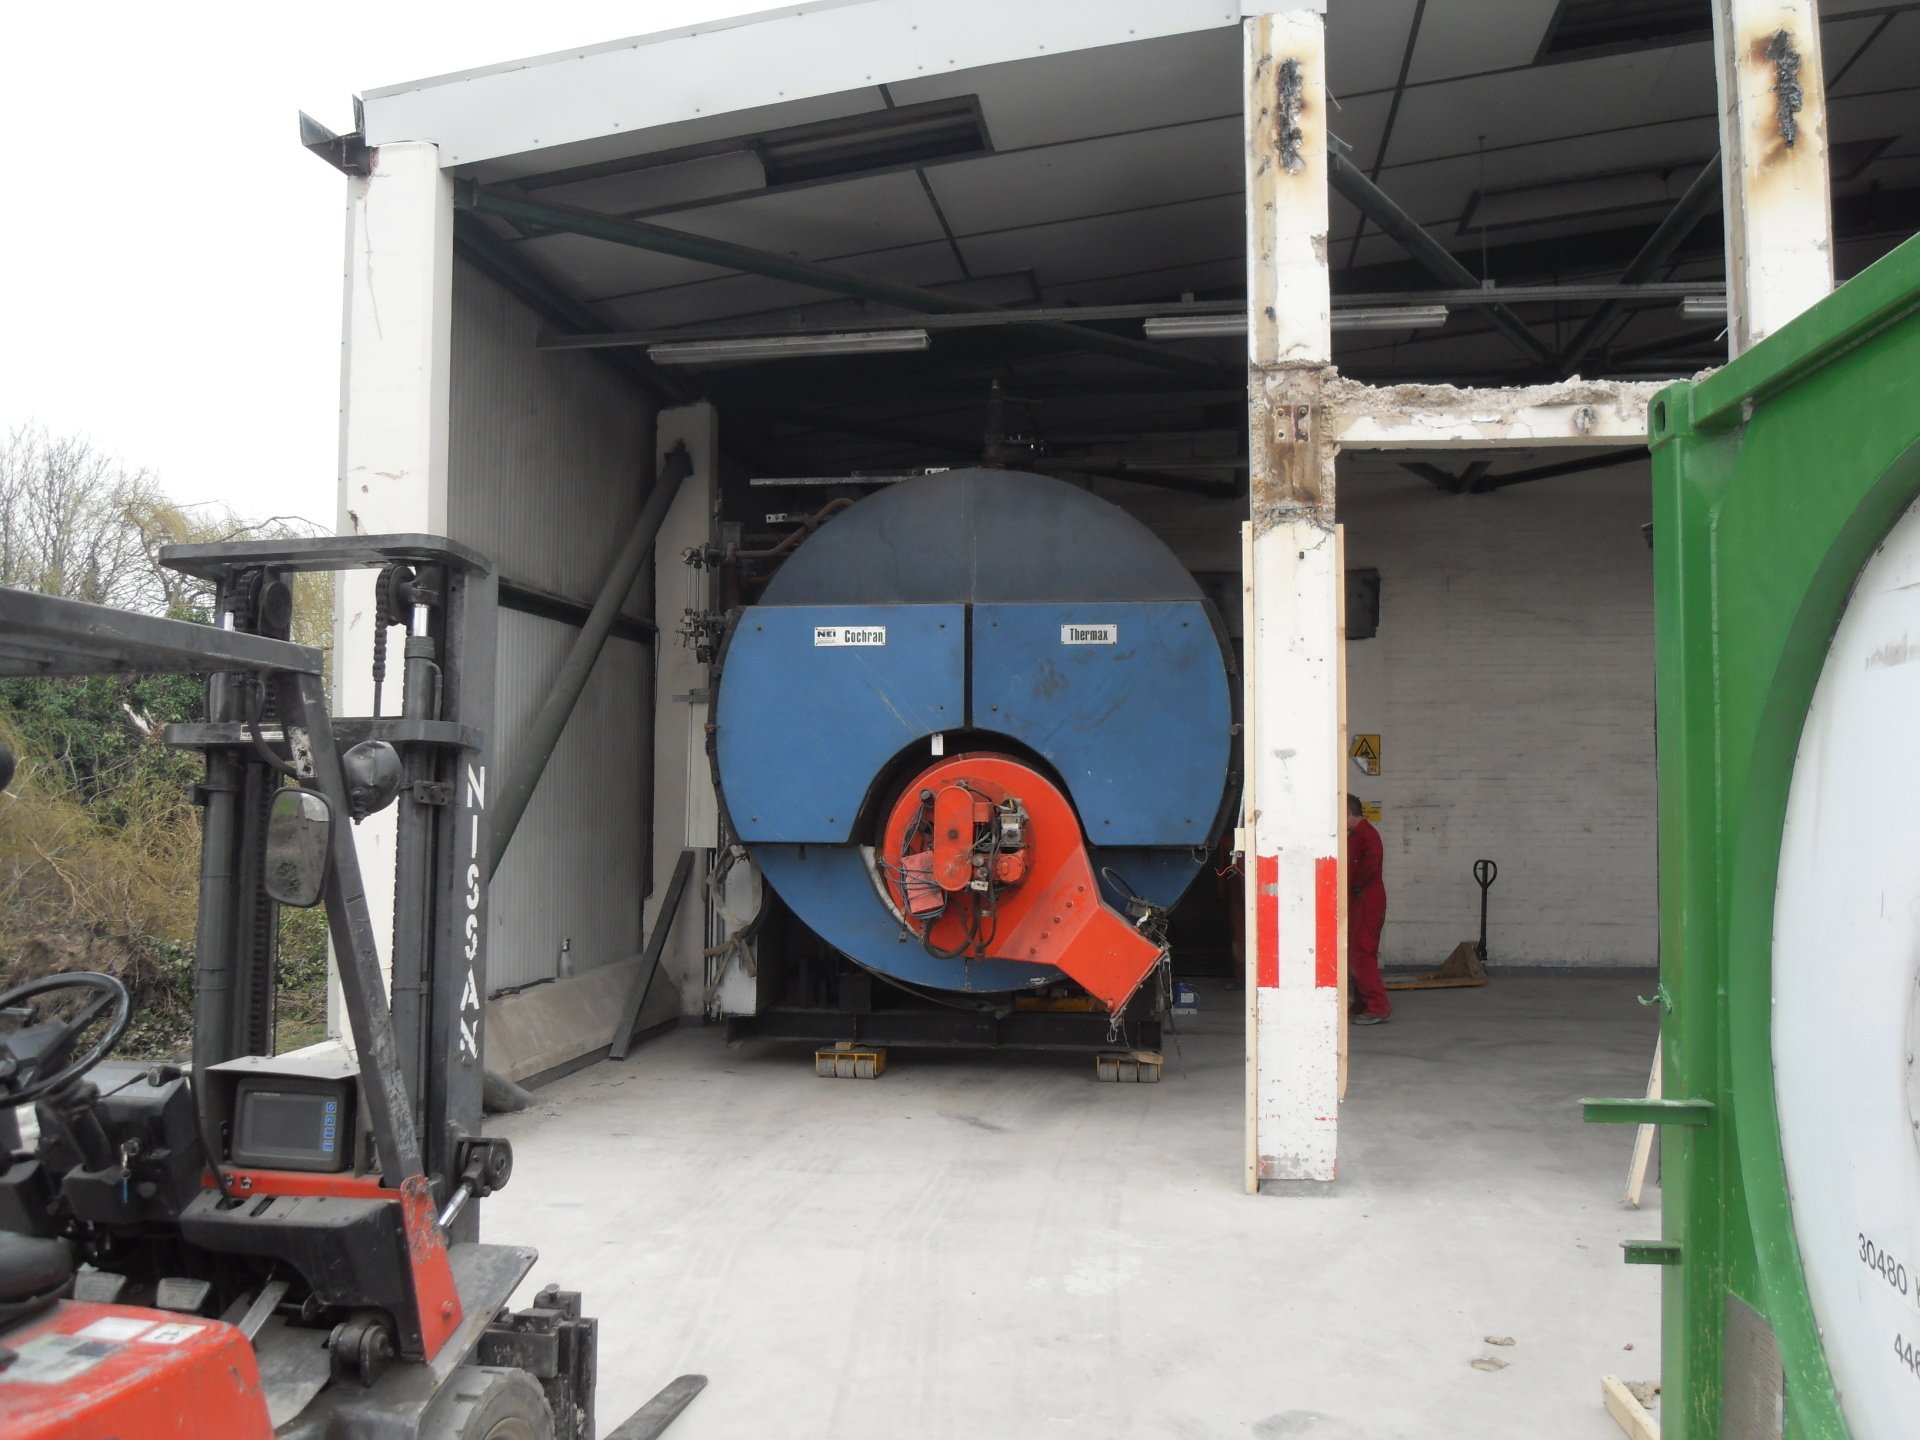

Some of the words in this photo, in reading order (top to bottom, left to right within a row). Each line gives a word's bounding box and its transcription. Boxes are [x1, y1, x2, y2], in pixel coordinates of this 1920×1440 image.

[817, 630, 836, 638] NEI
[844, 629, 883, 643] Cochran
[1069, 628, 1108, 641] Thermax
[460, 763, 485, 1062] NISSAN
[1858, 1232, 1907, 1296] 30480
